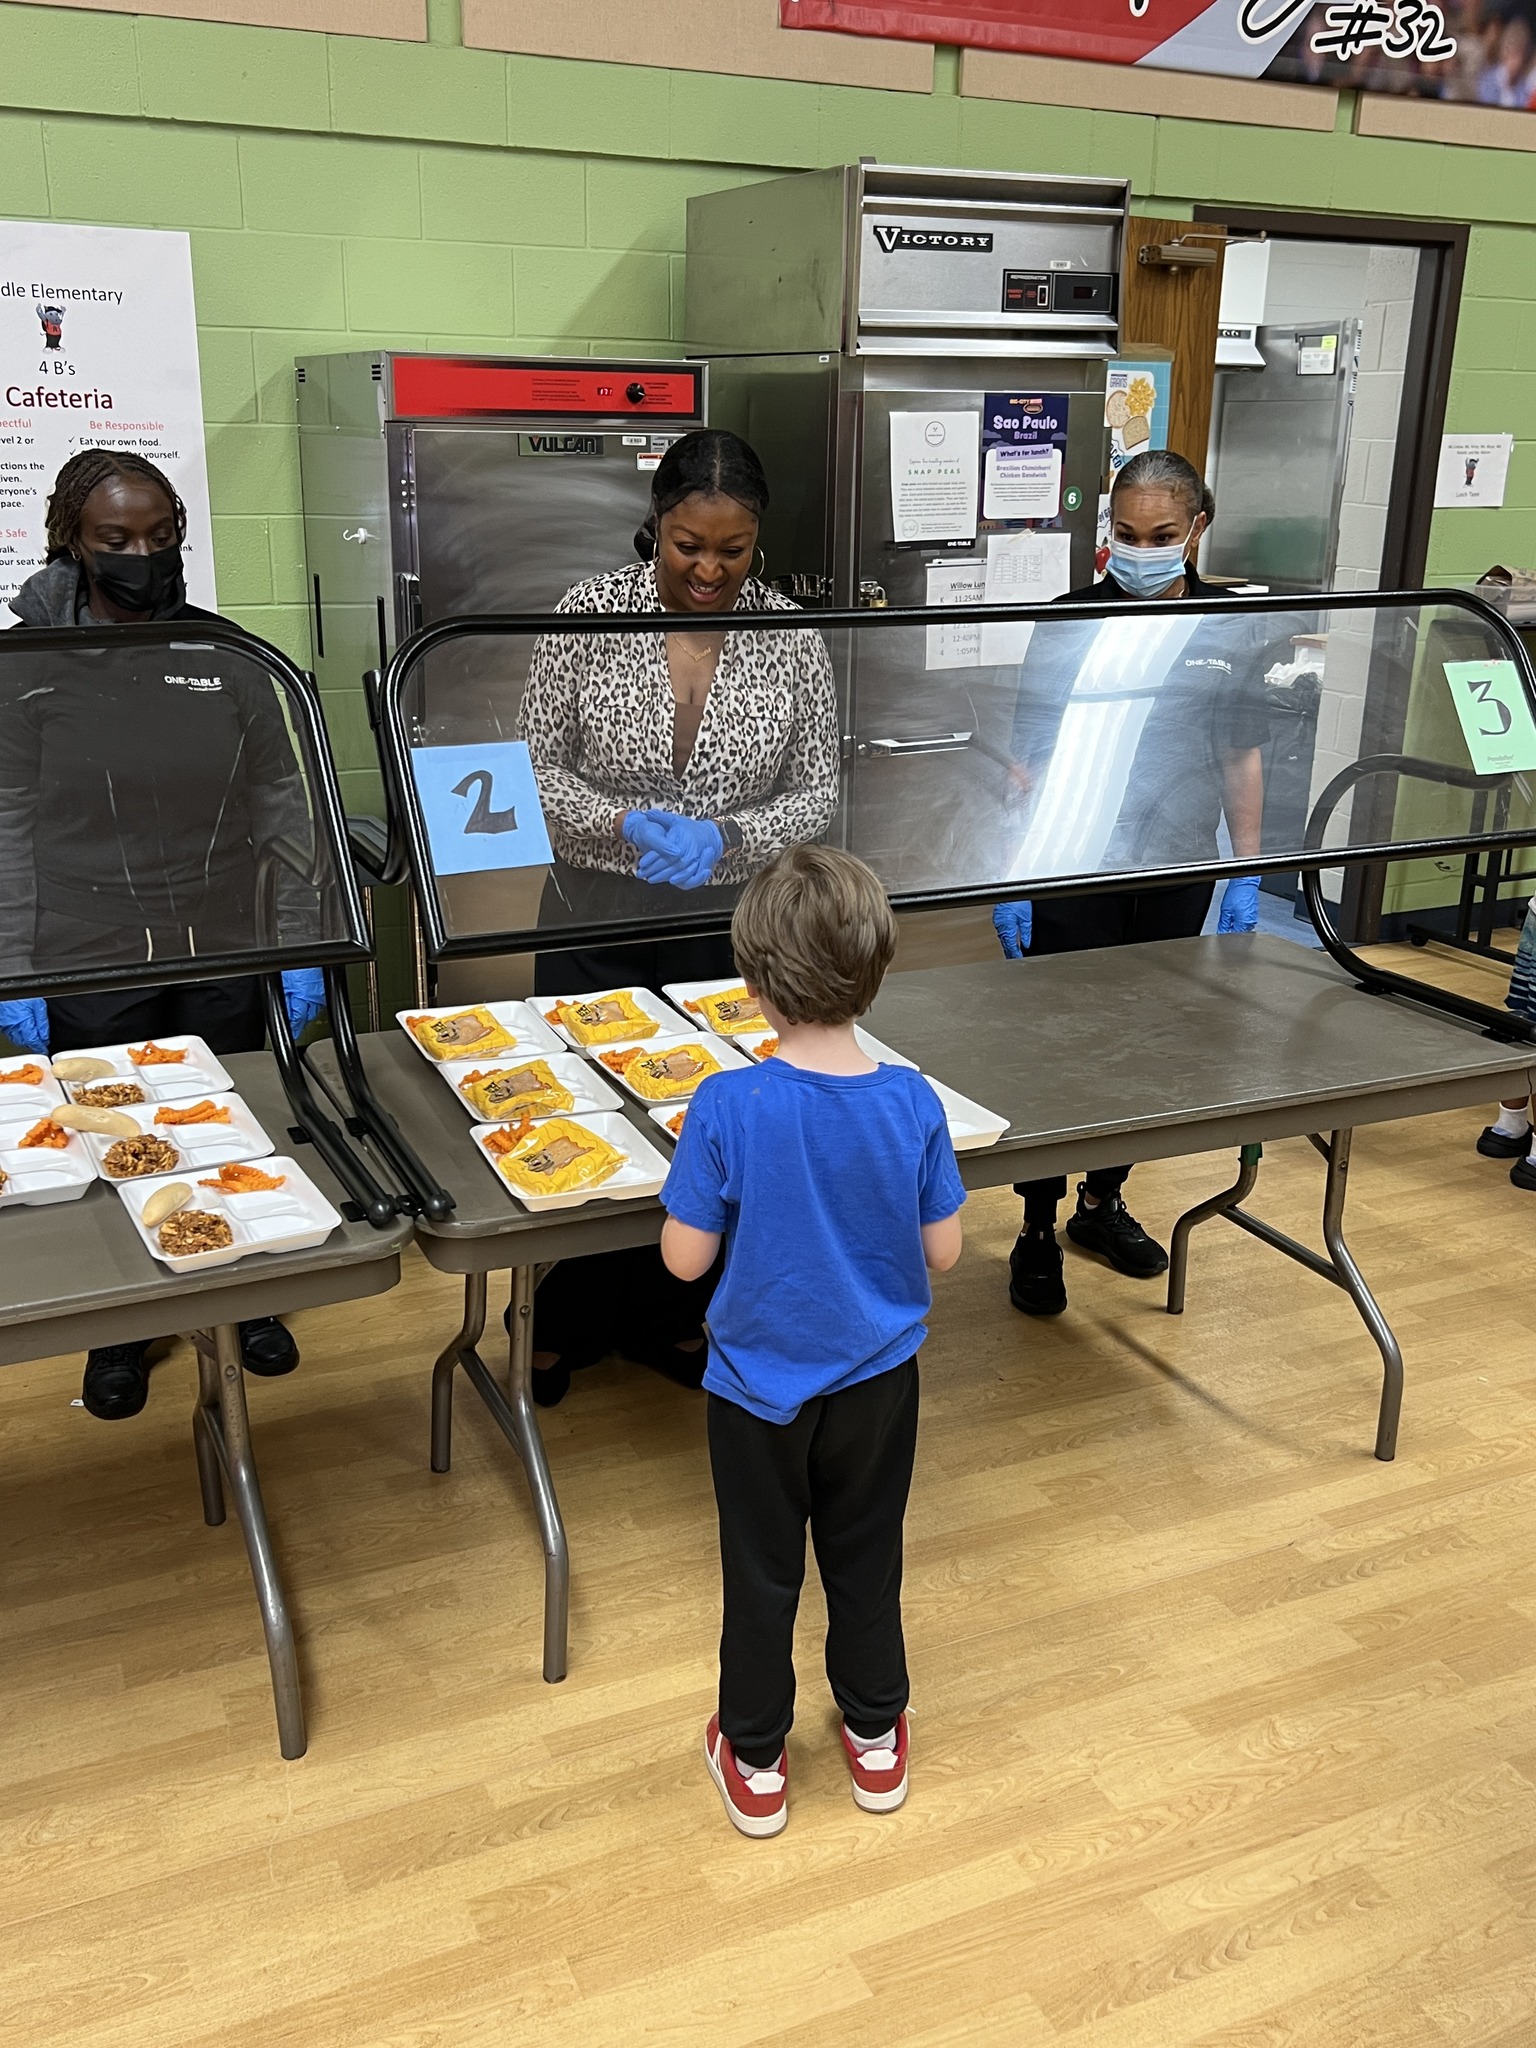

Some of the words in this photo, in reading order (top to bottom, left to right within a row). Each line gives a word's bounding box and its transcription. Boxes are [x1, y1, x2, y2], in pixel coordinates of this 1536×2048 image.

[1311, 0, 1456, 60] #32
[876, 227, 990, 250] VICTORY
[31, 283, 123, 305] Elementary
[39, 361, 48, 375] 4
[6, 386, 113, 409] Cafeteria
[89, 420, 102, 430] Be
[105, 421, 164, 431] Responsible
[993, 415, 1020, 430] Sao
[1022, 415, 1058, 430] Paulo
[16, 436, 22, 445] 2
[24, 437, 34, 445] or
[1013, 431, 1038, 440] Brazil
[79, 437, 93, 446] Eat
[95, 438, 115, 447] your
[139, 438, 161, 447] food.
[528, 435, 597, 454] VULCAN
[143, 450, 180, 459] yourself.
[1030, 448, 1050, 456] lunch?
[30, 461, 45, 471] the
[1067, 492, 1077, 505] 6
[6, 528, 27, 538] Safe
[16, 558, 35, 566] seat
[950, 582, 973, 590] Willow
[954, 594, 983, 603] 11:25AM
[1467, 680, 1512, 736] 3
[451, 770, 519, 834] 2
